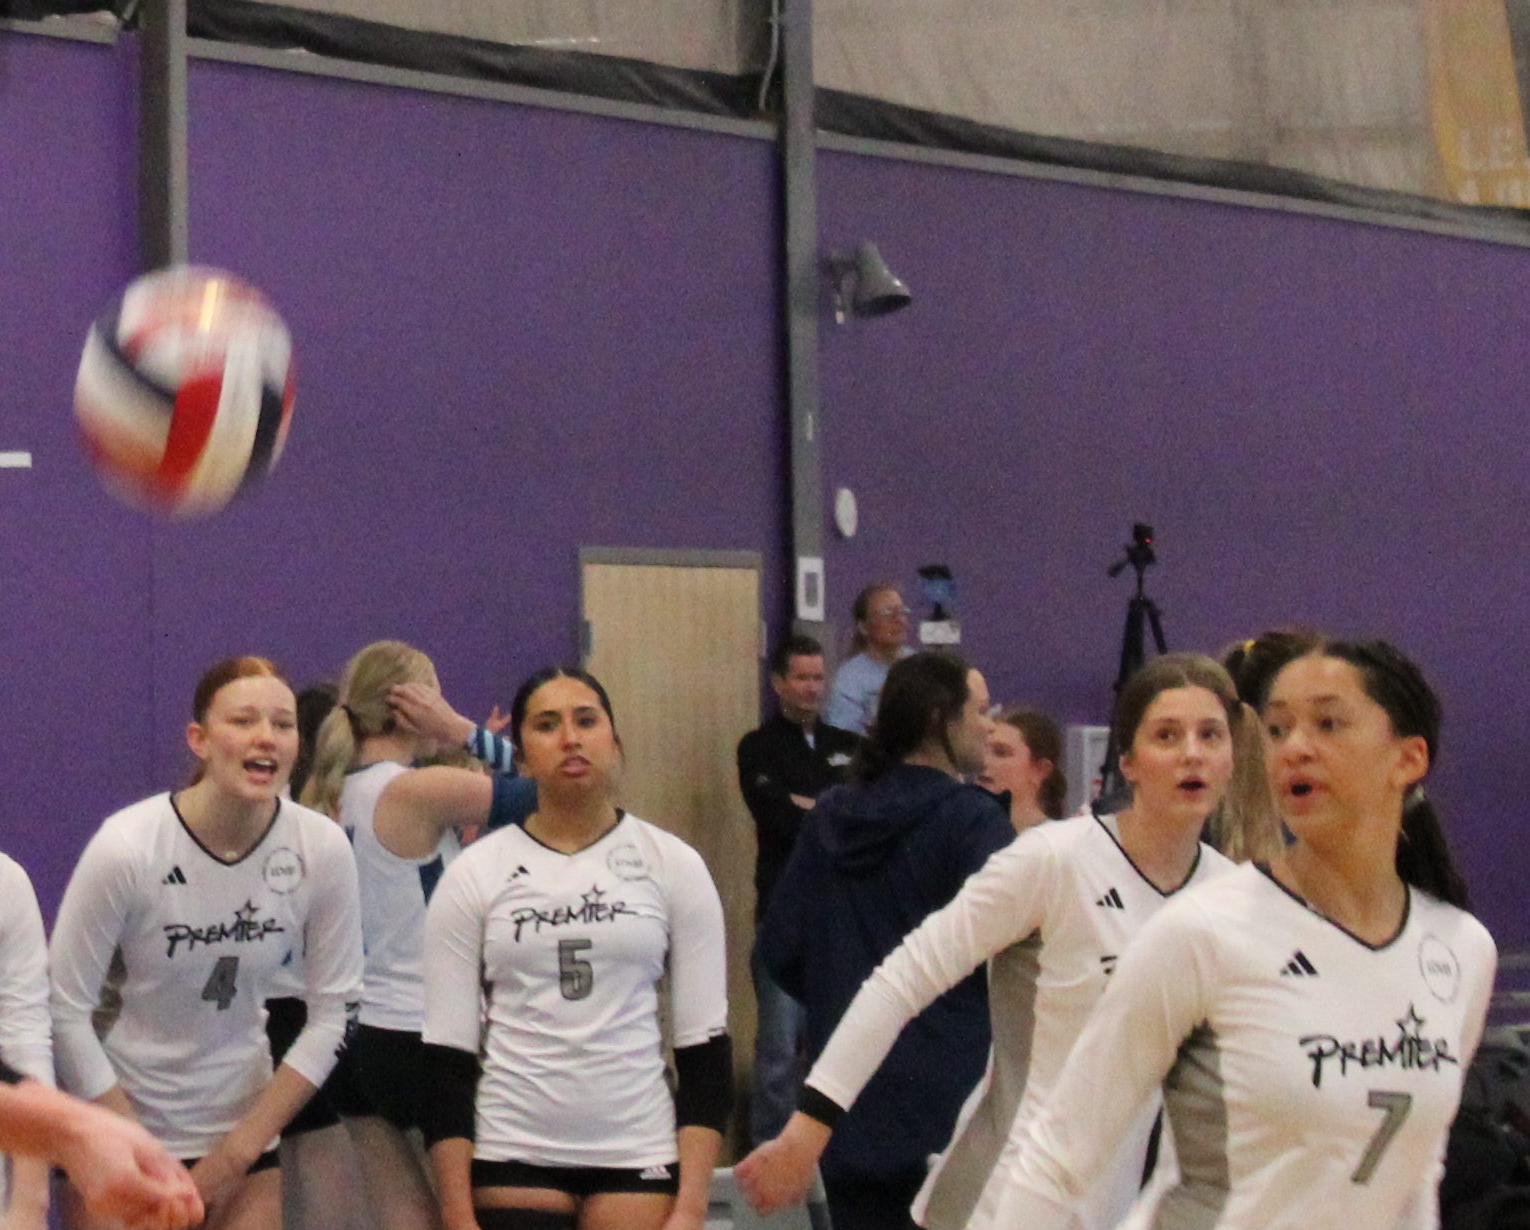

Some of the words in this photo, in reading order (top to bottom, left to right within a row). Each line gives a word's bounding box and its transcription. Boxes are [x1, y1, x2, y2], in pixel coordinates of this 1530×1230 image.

[163, 899, 285, 958] PREMIER
[510, 883, 638, 942] PREMIER
[201, 956, 239, 1011] 4
[558, 938, 594, 1000] 5
[1299, 1000, 1458, 1089] PREMIER
[1351, 1089, 1413, 1184] 7
